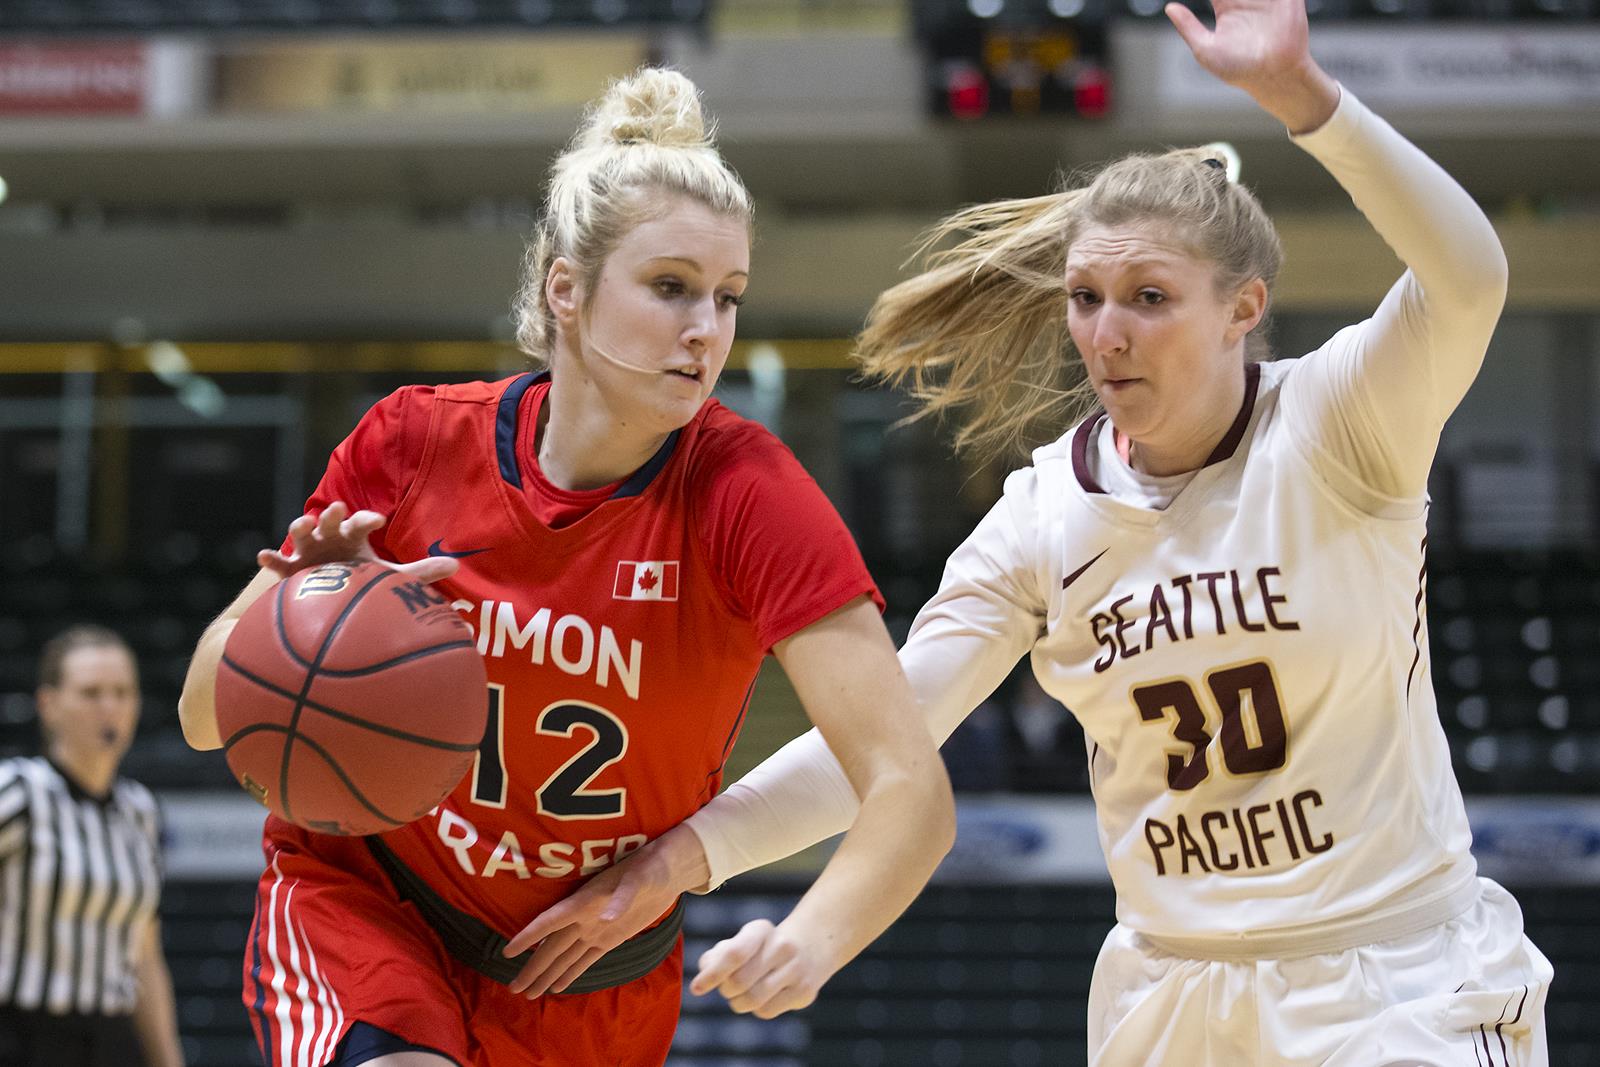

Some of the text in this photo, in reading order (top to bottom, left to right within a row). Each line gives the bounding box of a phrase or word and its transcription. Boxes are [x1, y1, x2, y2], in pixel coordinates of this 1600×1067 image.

[1090, 567, 1300, 673] SEATTLE
[470, 682, 629, 821] 12
[1128, 656, 1292, 792] 30
[428, 806, 648, 880] RASE
[1143, 789, 1334, 876] PACIFIC
